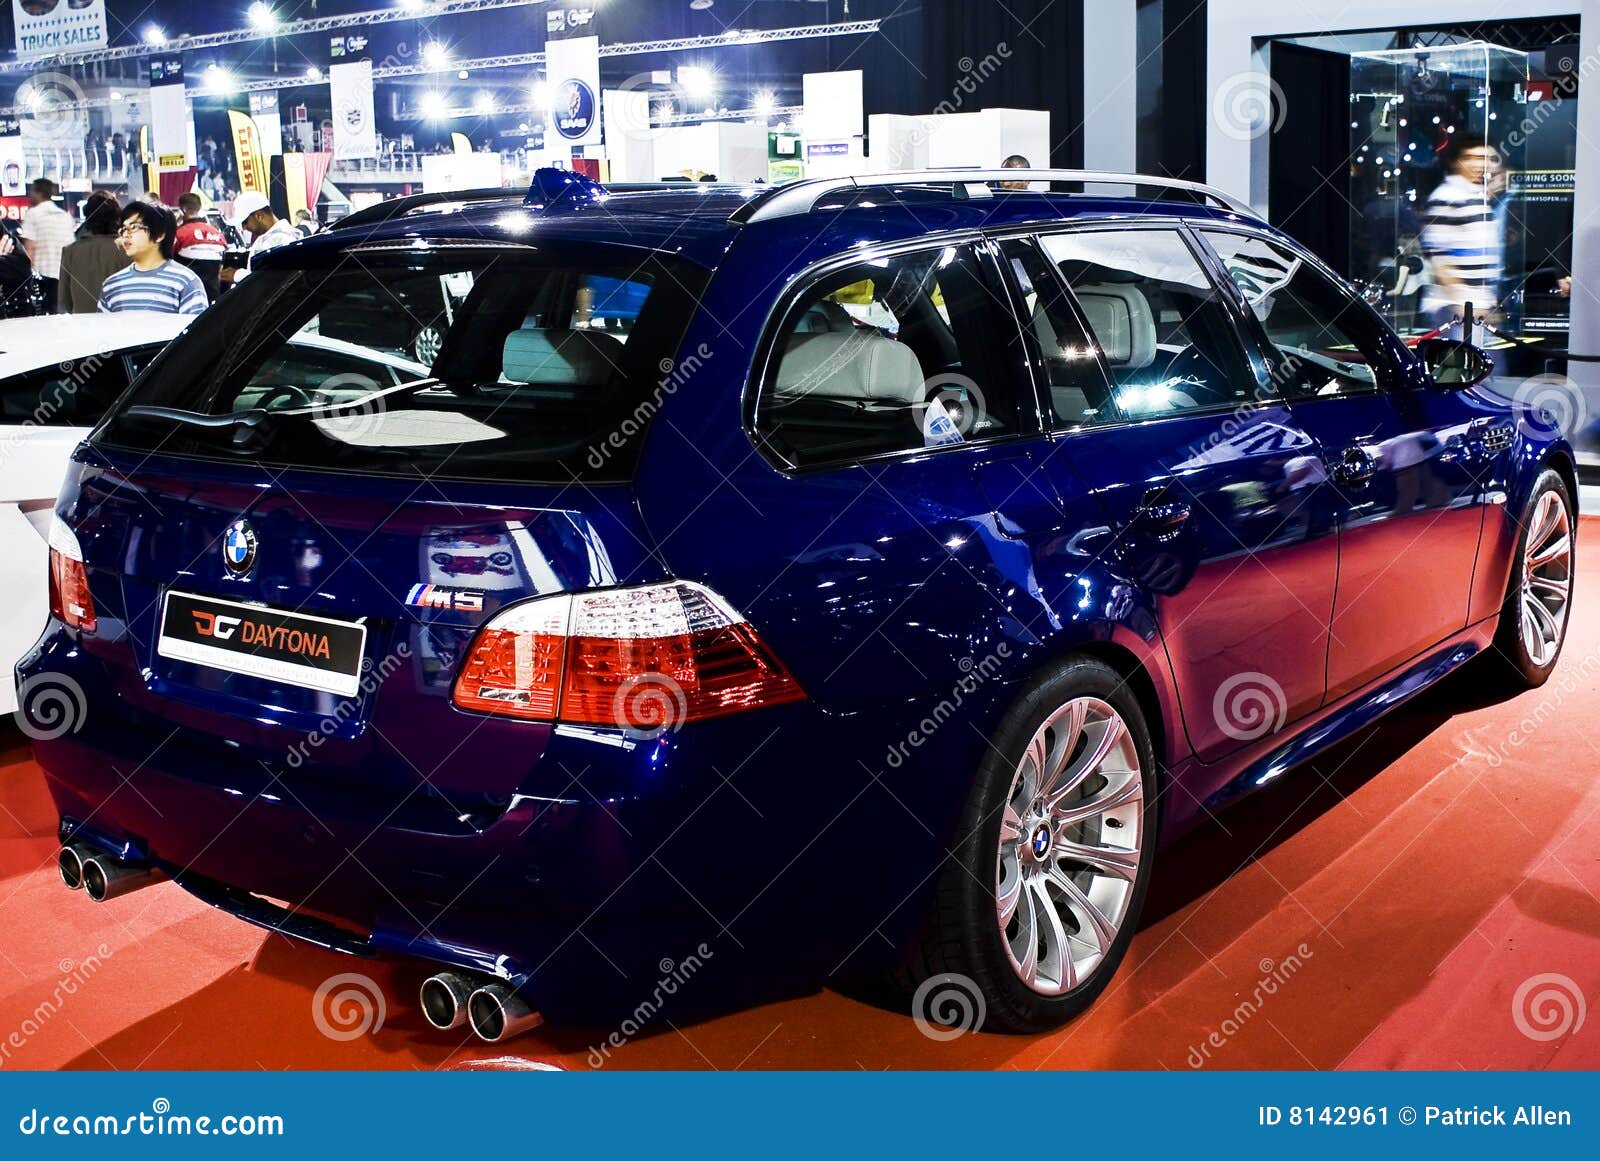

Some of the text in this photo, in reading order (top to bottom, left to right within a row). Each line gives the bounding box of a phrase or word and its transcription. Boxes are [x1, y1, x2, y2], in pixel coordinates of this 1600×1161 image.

[20, 25, 100, 51] TRUCK SALES
[1510, 174, 1576, 182] COMING SOON
[420, 586, 485, 612] M5
[242, 621, 330, 659] DAYTONA
